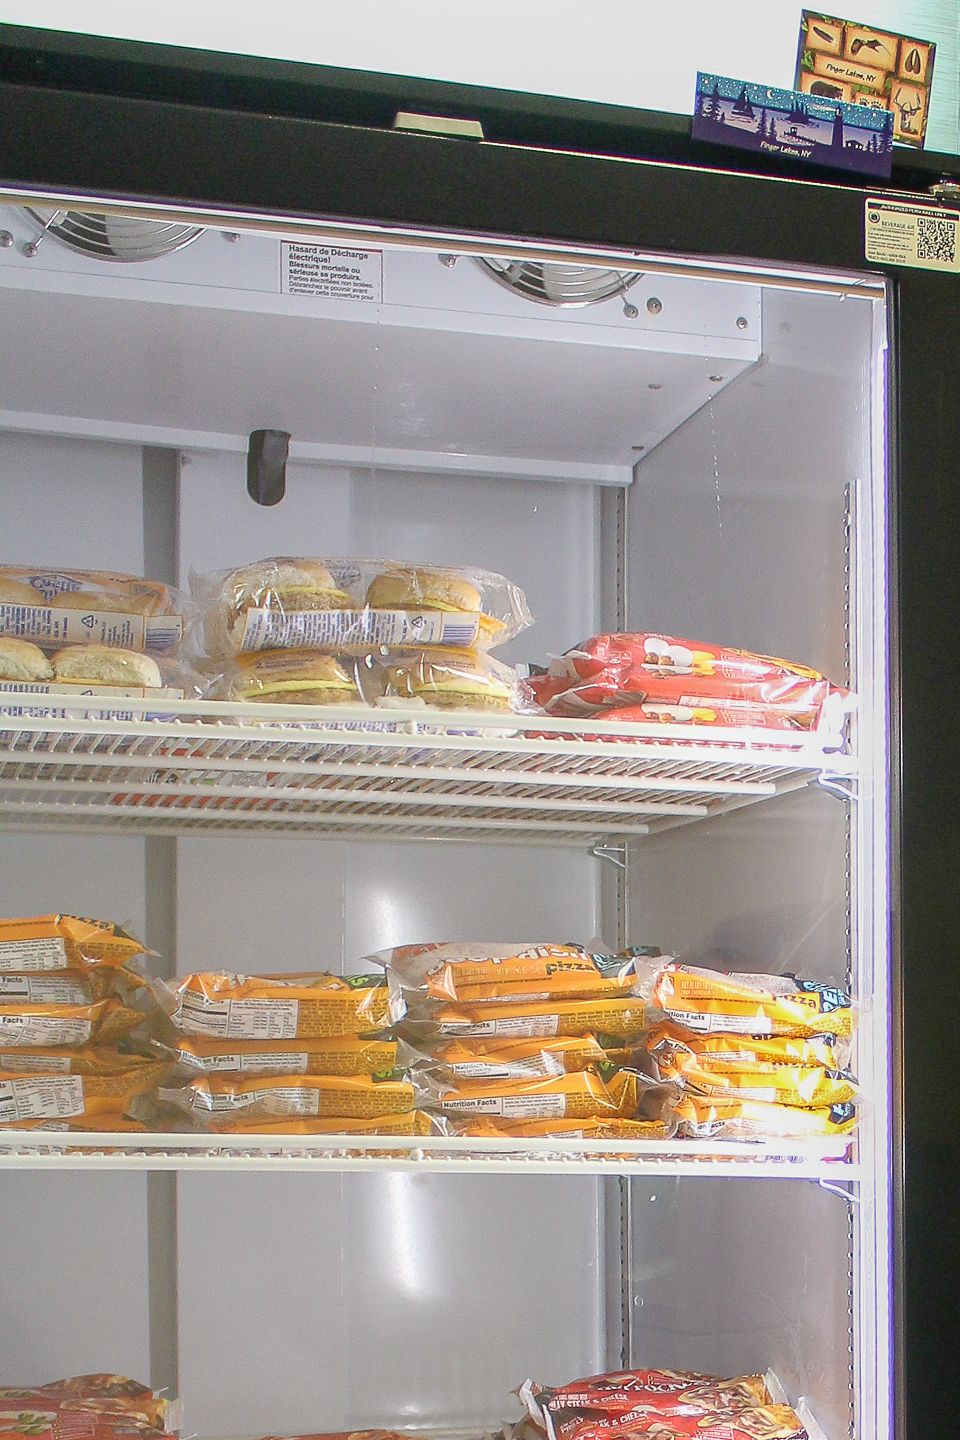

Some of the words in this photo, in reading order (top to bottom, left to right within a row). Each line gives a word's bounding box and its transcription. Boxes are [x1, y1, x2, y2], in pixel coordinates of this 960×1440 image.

[826, 63, 845, 74] Finger
[845, 69, 865, 80] Lakes,
[866, 74, 876, 82] NY
[760, 141, 779, 151] Finger
[780, 145, 800, 156] Lakes,
[801, 150, 811, 158] NY
[289, 245, 317, 254] Hasard
[331, 249, 369, 260] Décharge
[289, 261, 319, 270] Blessure
[321, 263, 349, 272] mortelle
[289, 268, 318, 276] sérieuse
[546, 961, 595, 975] pizza
[2, 1016, 23, 1024] Facts
[686, 1012, 705, 1020] Facts
